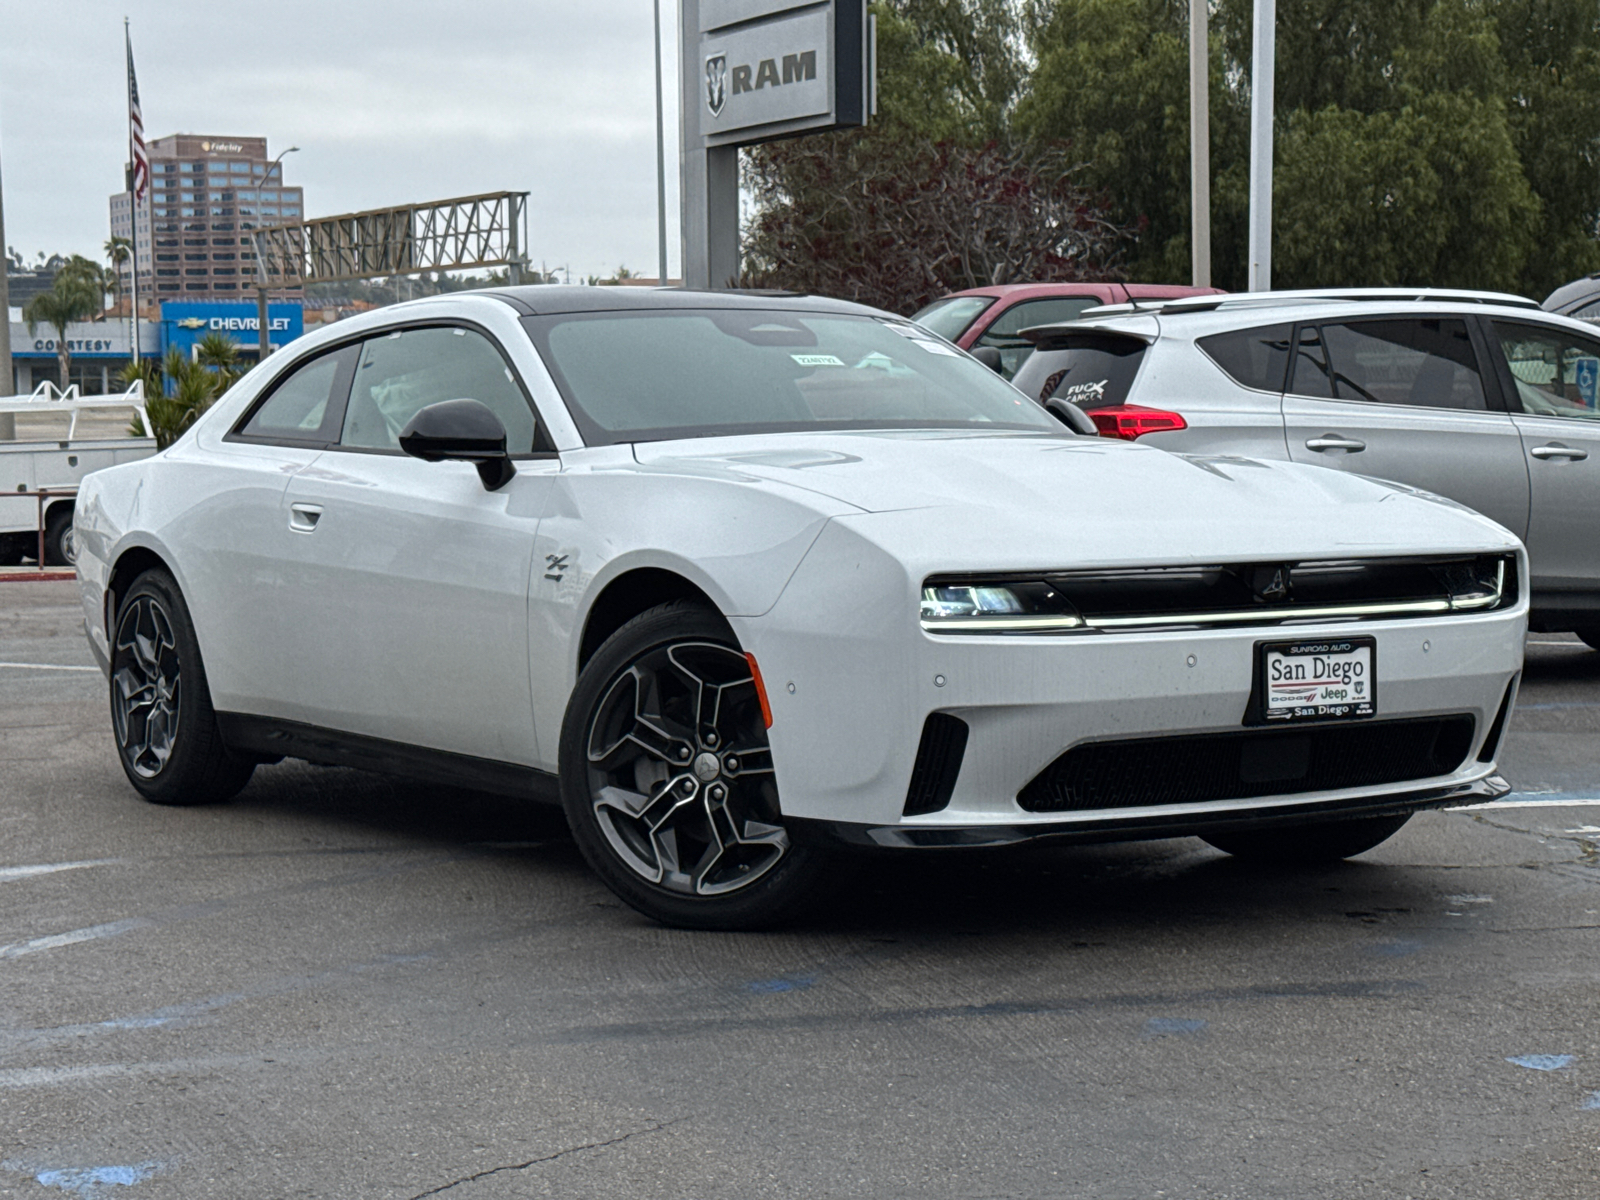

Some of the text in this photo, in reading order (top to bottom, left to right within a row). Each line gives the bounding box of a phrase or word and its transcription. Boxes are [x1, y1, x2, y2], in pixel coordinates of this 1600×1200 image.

[732, 50, 816, 96] RAM
[211, 142, 243, 153] Fidelity
[1067, 379, 1109, 396] FUCK
[1290, 646, 1329, 654] SUNROAD
[1271, 655, 1364, 685] San Diego
[1320, 686, 1348, 701] Jeep
[1294, 705, 1349, 716] San Diego
